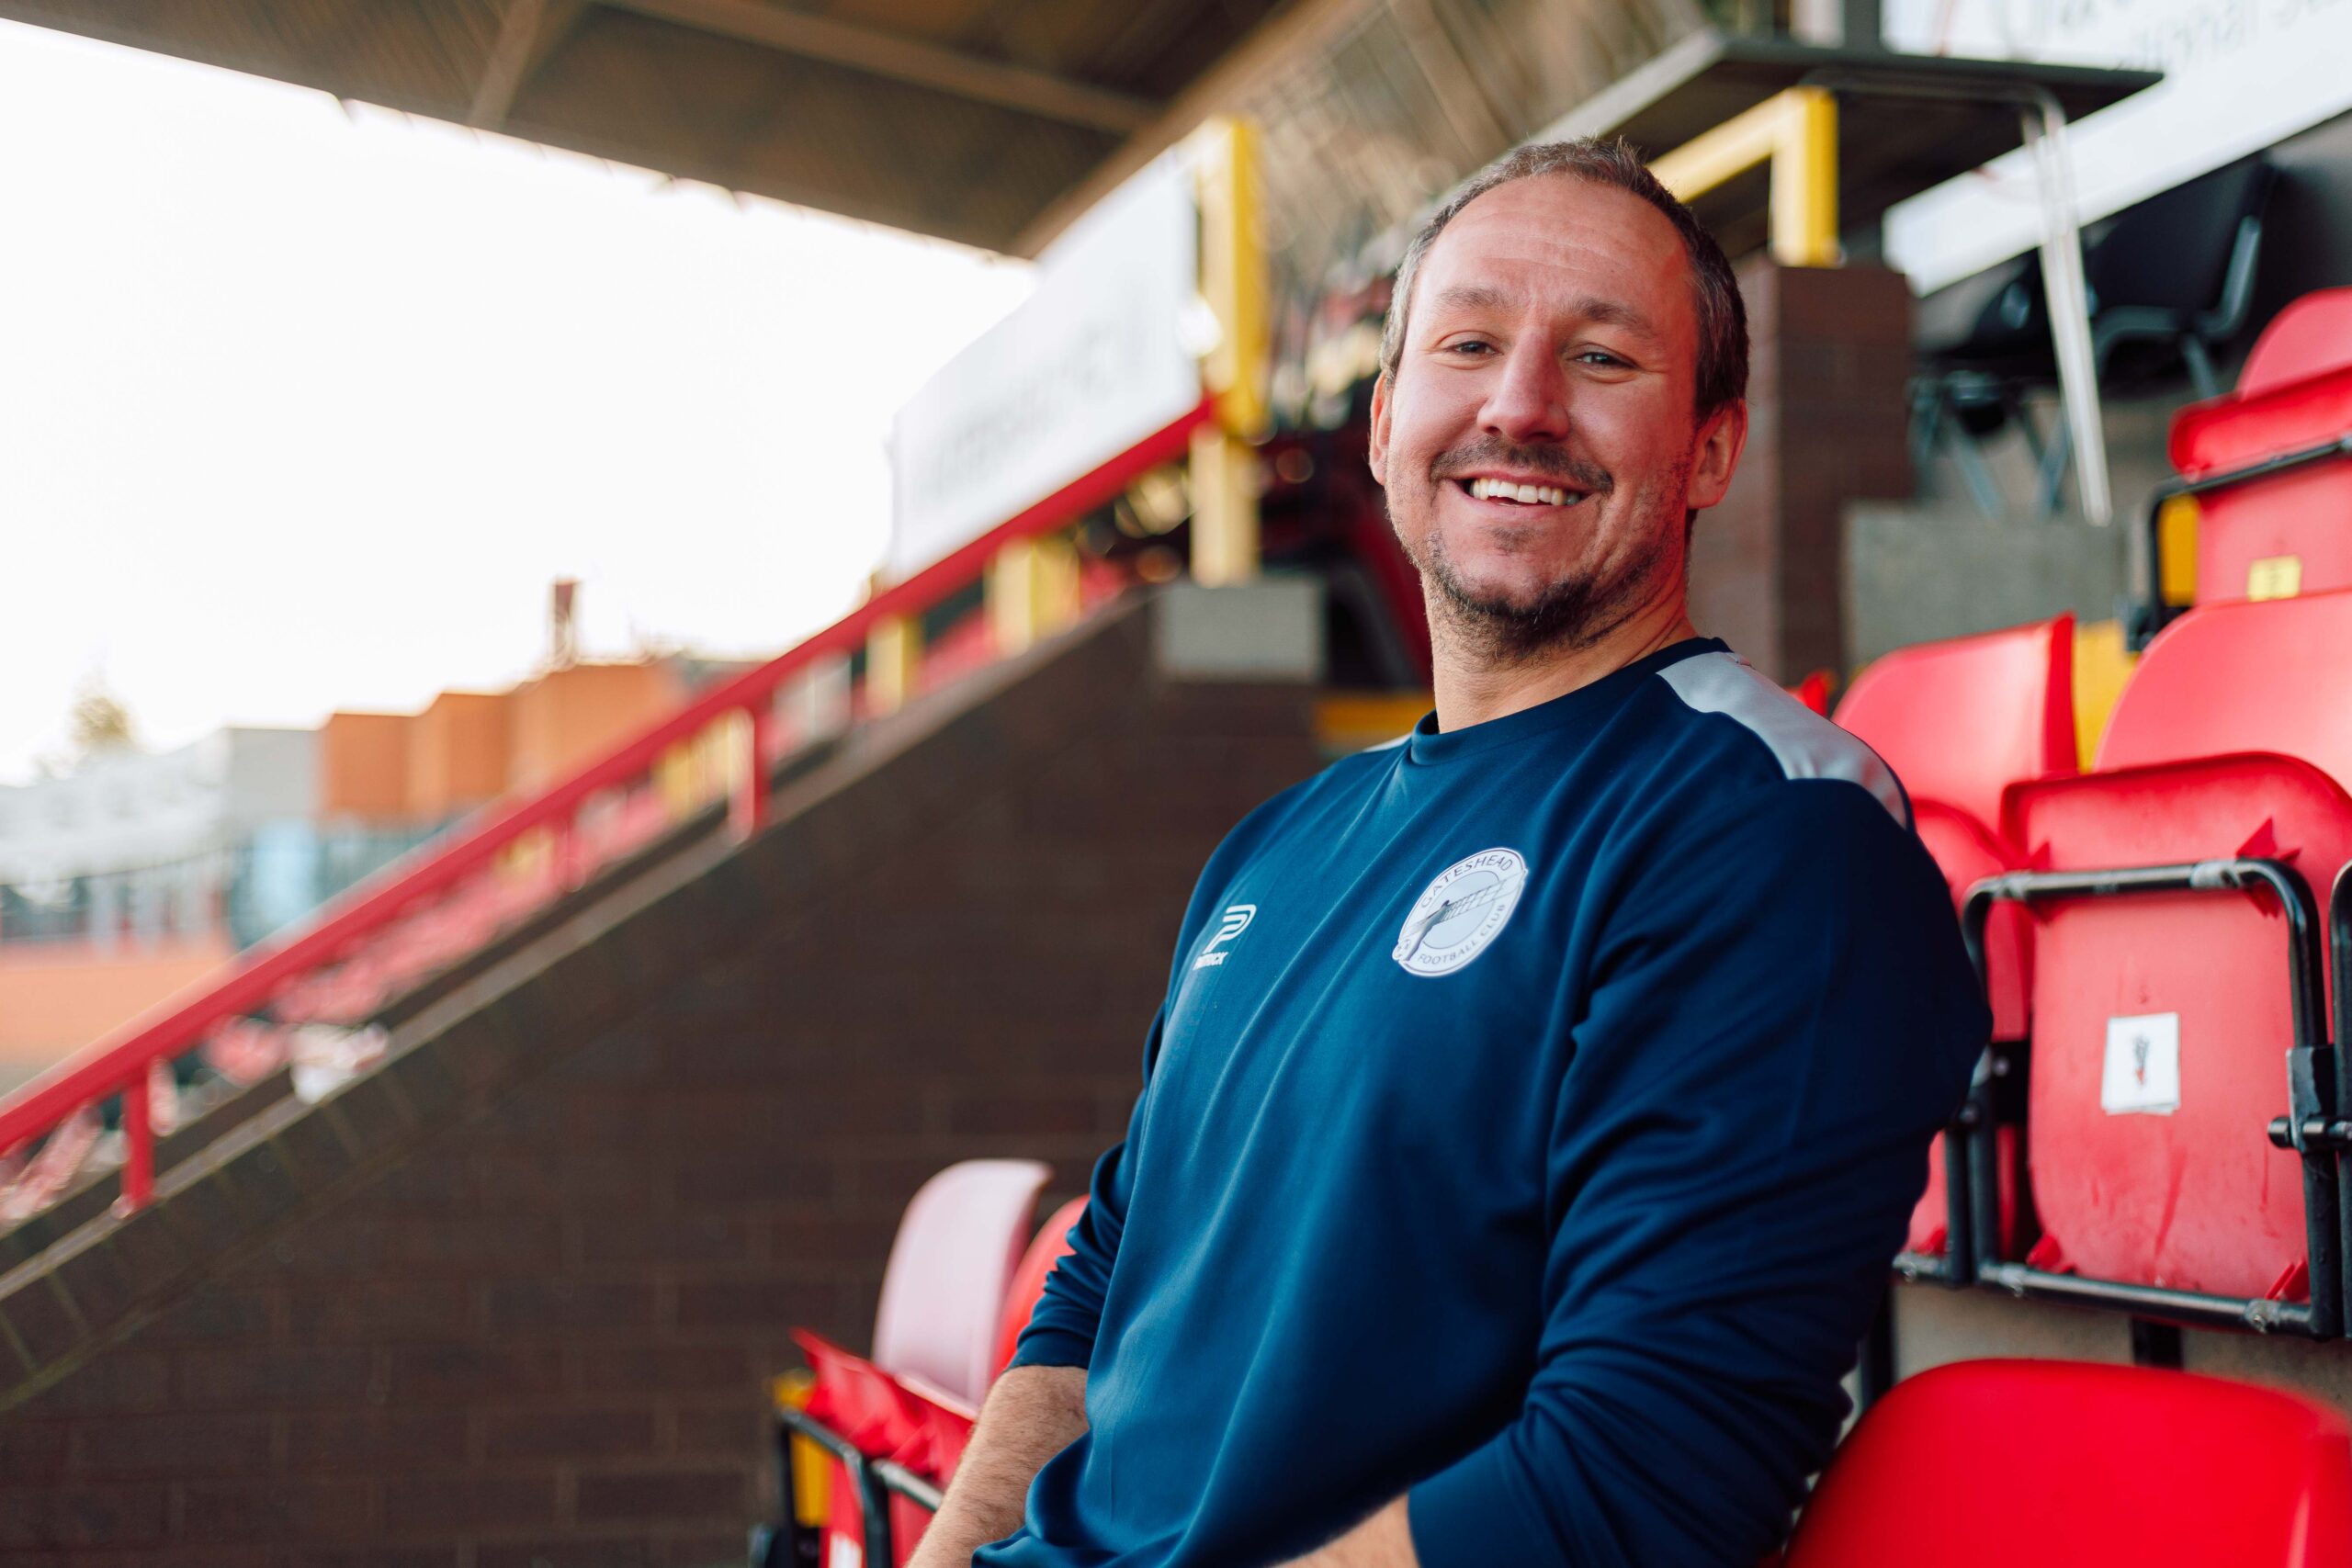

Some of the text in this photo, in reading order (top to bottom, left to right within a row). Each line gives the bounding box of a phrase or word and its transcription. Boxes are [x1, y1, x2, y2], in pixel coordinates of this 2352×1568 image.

[1420, 854, 1514, 908] GATESHEAD
[1418, 904, 1506, 964] FOOTBALL CLUB
